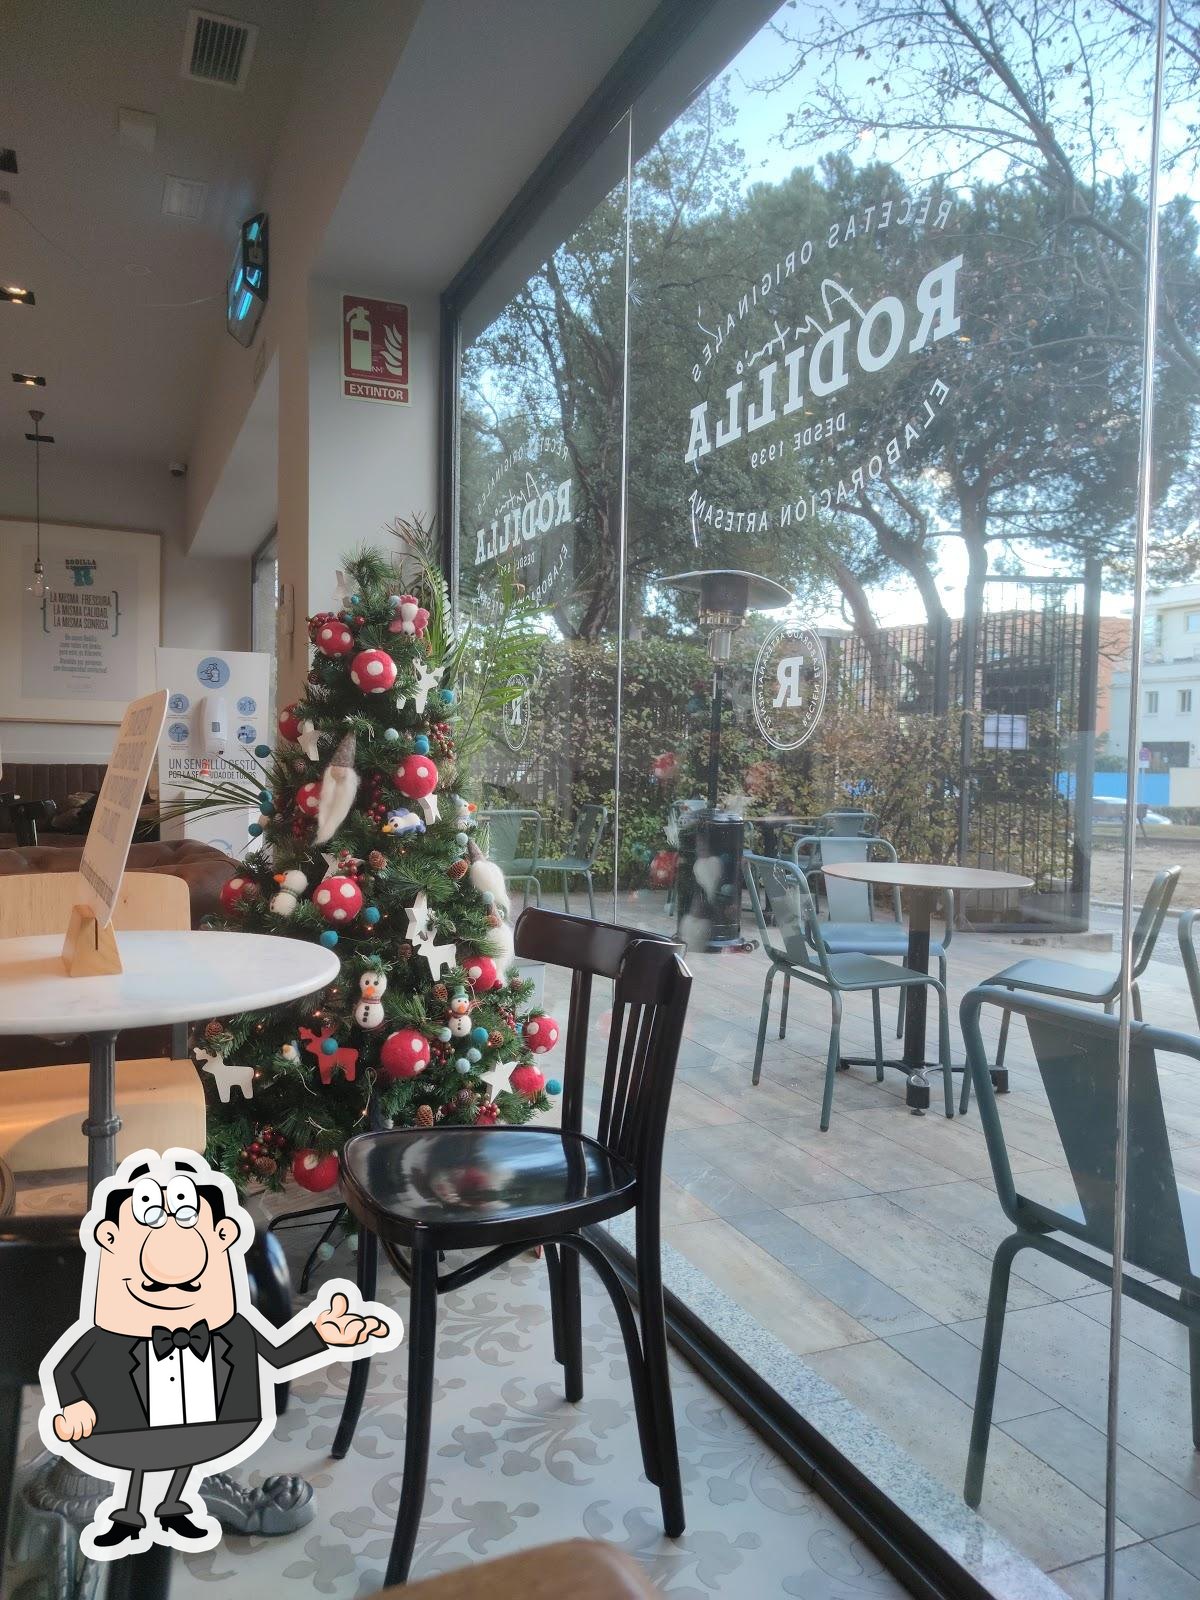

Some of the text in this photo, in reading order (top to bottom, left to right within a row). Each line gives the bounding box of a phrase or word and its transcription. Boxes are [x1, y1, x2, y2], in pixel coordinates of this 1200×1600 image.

[349, 383, 404, 400] EXTINTOR
[53, 604, 60, 616] LA
[53, 616, 60, 628] LA
[168, 758, 182, 770] UN
